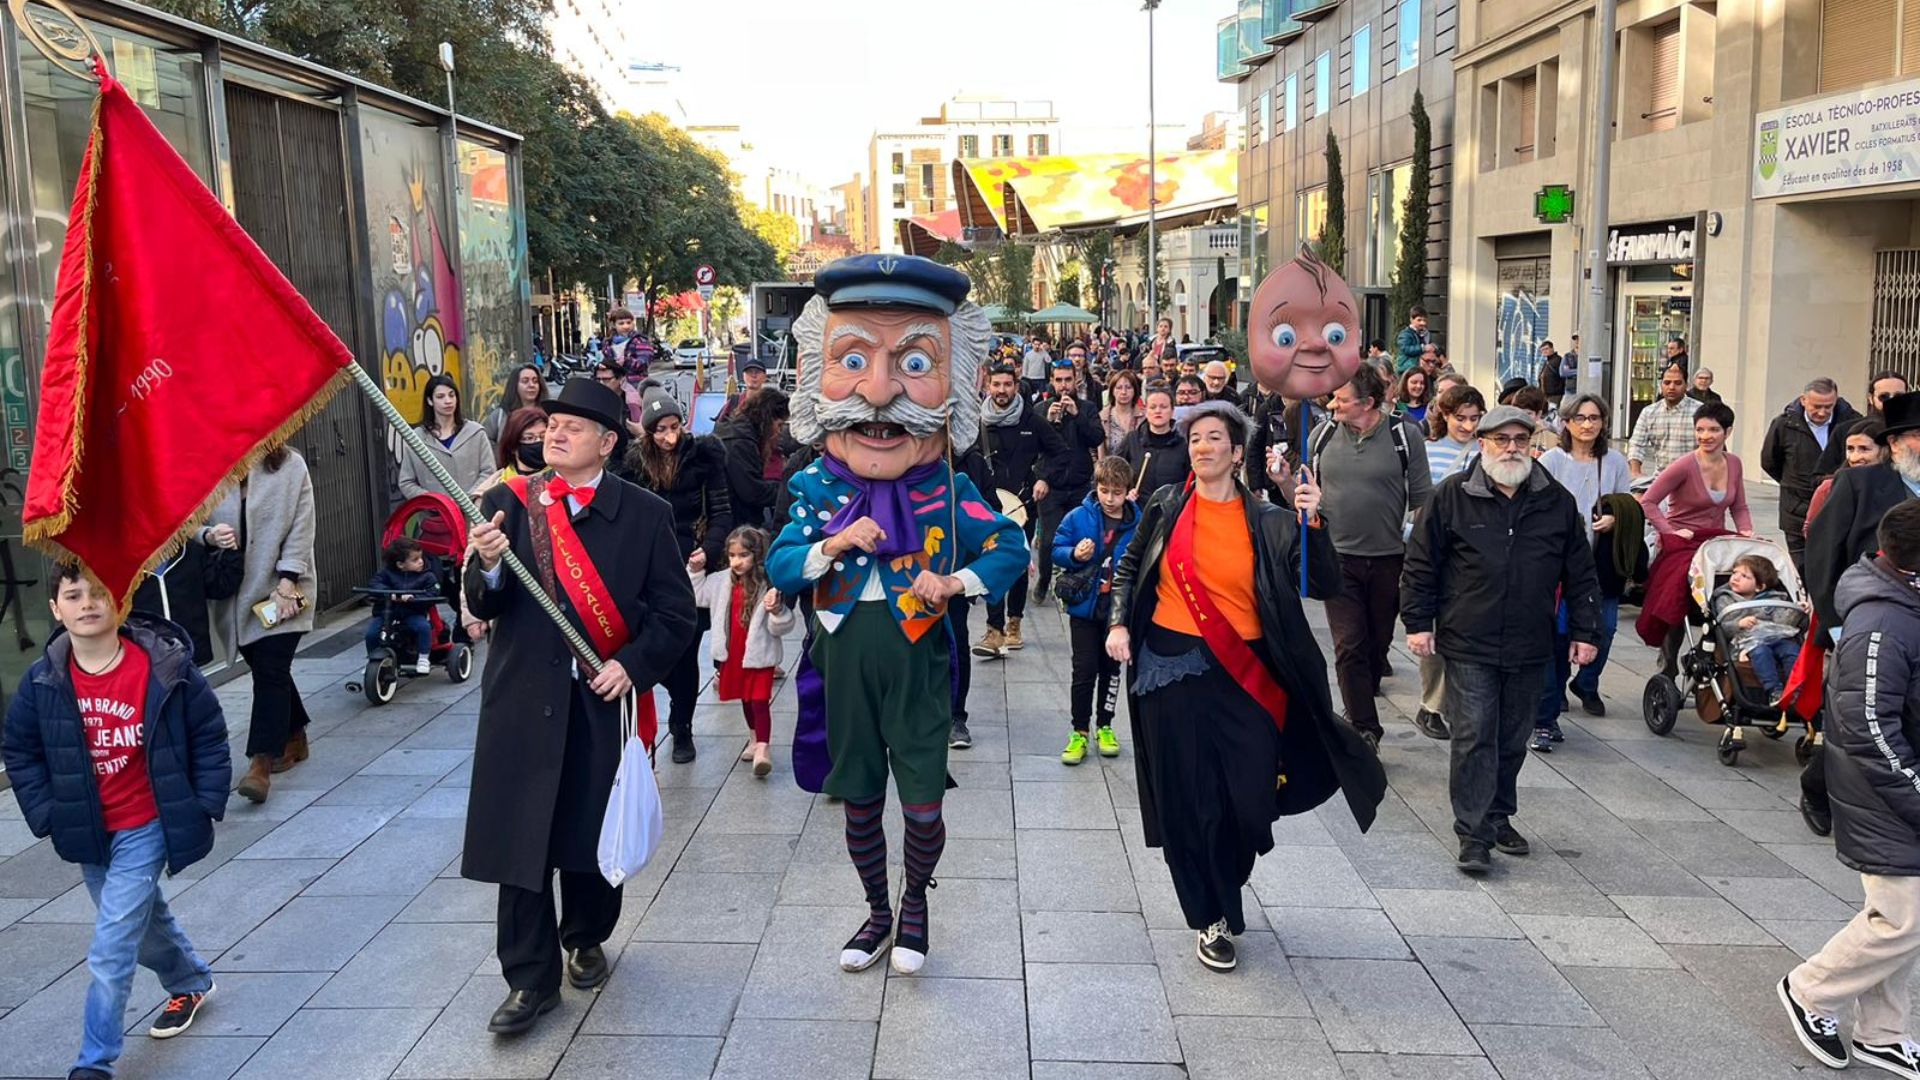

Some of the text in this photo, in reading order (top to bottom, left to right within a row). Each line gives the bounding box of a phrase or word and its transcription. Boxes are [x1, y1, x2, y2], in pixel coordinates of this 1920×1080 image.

[1786, 112, 1823, 129] ESCOLA
[1785, 128, 1850, 161] XAVIER
[1855, 139, 1878, 150] CICLES
[1879, 133, 1916, 146] FORMATIUS
[1783, 172, 1810, 185] Educant
[1811, 173, 1820, 182] en
[1853, 164, 1866, 176] des
[1869, 162, 1879, 174] de
[1882, 160, 1903, 173] 1958
[130, 358, 173, 401] 1990
[12, 407, 19, 421] 1
[14, 429, 24, 444] 2
[17, 451, 27, 466] 3
[95, 697, 136, 720] BRAND
[83, 717, 103, 727] 1973
[94, 723, 144, 747] JEANS
